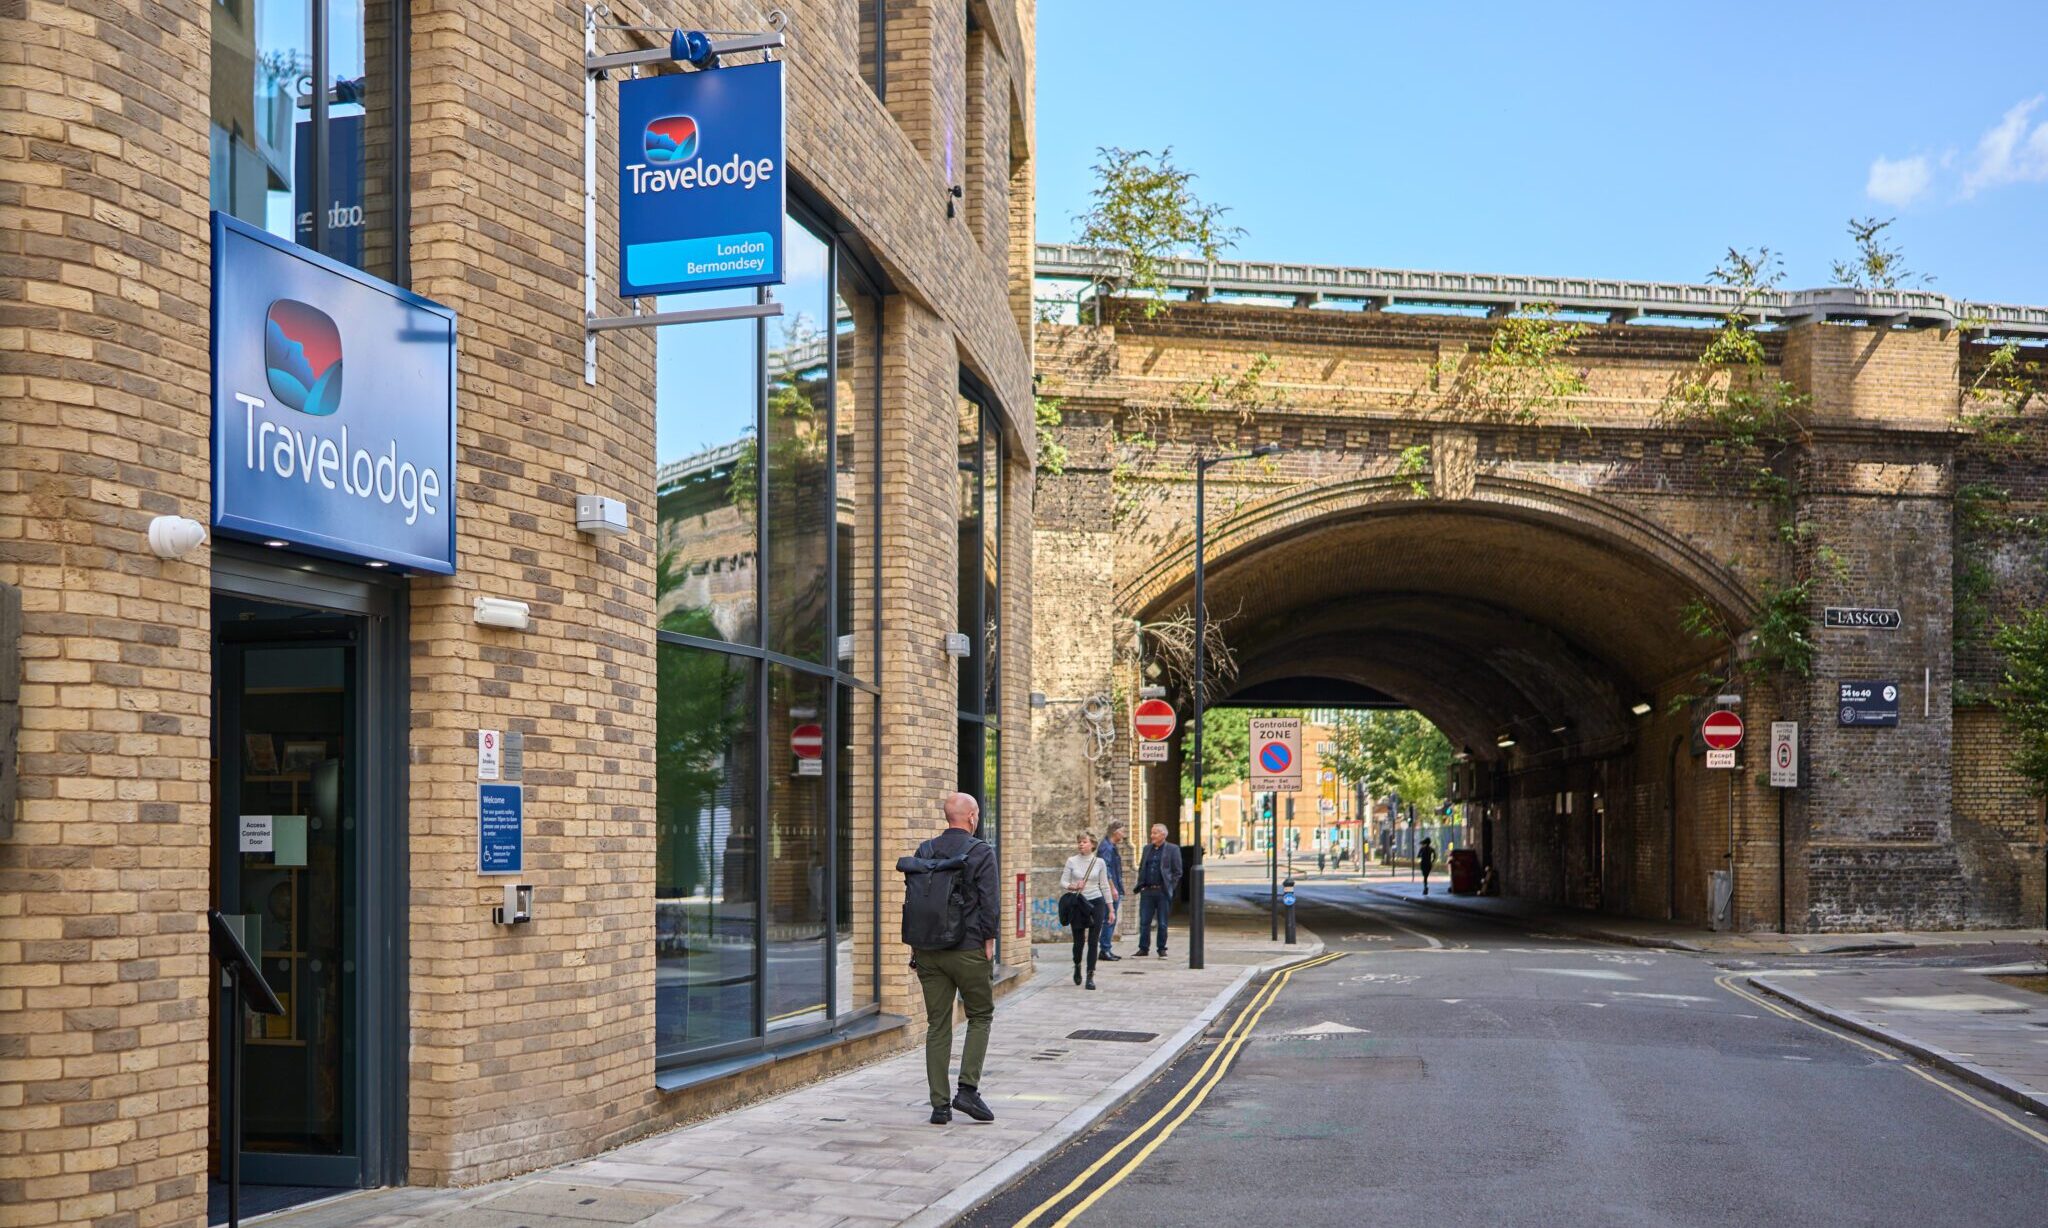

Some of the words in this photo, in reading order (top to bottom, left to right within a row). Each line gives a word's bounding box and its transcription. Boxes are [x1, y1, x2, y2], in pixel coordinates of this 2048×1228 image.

[625, 153, 774, 195] Travelodge
[717, 241, 765, 256] London
[687, 257, 765, 275] Bermondsey
[234, 392, 440, 526] Travelodge
[1837, 611, 1889, 625] LASSCO
[1841, 689, 1851, 698] 34
[1852, 689, 1861, 698] to
[1860, 689, 1871, 698] 40
[1253, 720, 1298, 729] Controlled
[1260, 730, 1291, 739] ZONE
[1141, 744, 1165, 752] Except
[1142, 751, 1164, 759] cycles
[482, 796, 505, 804] Welcome
